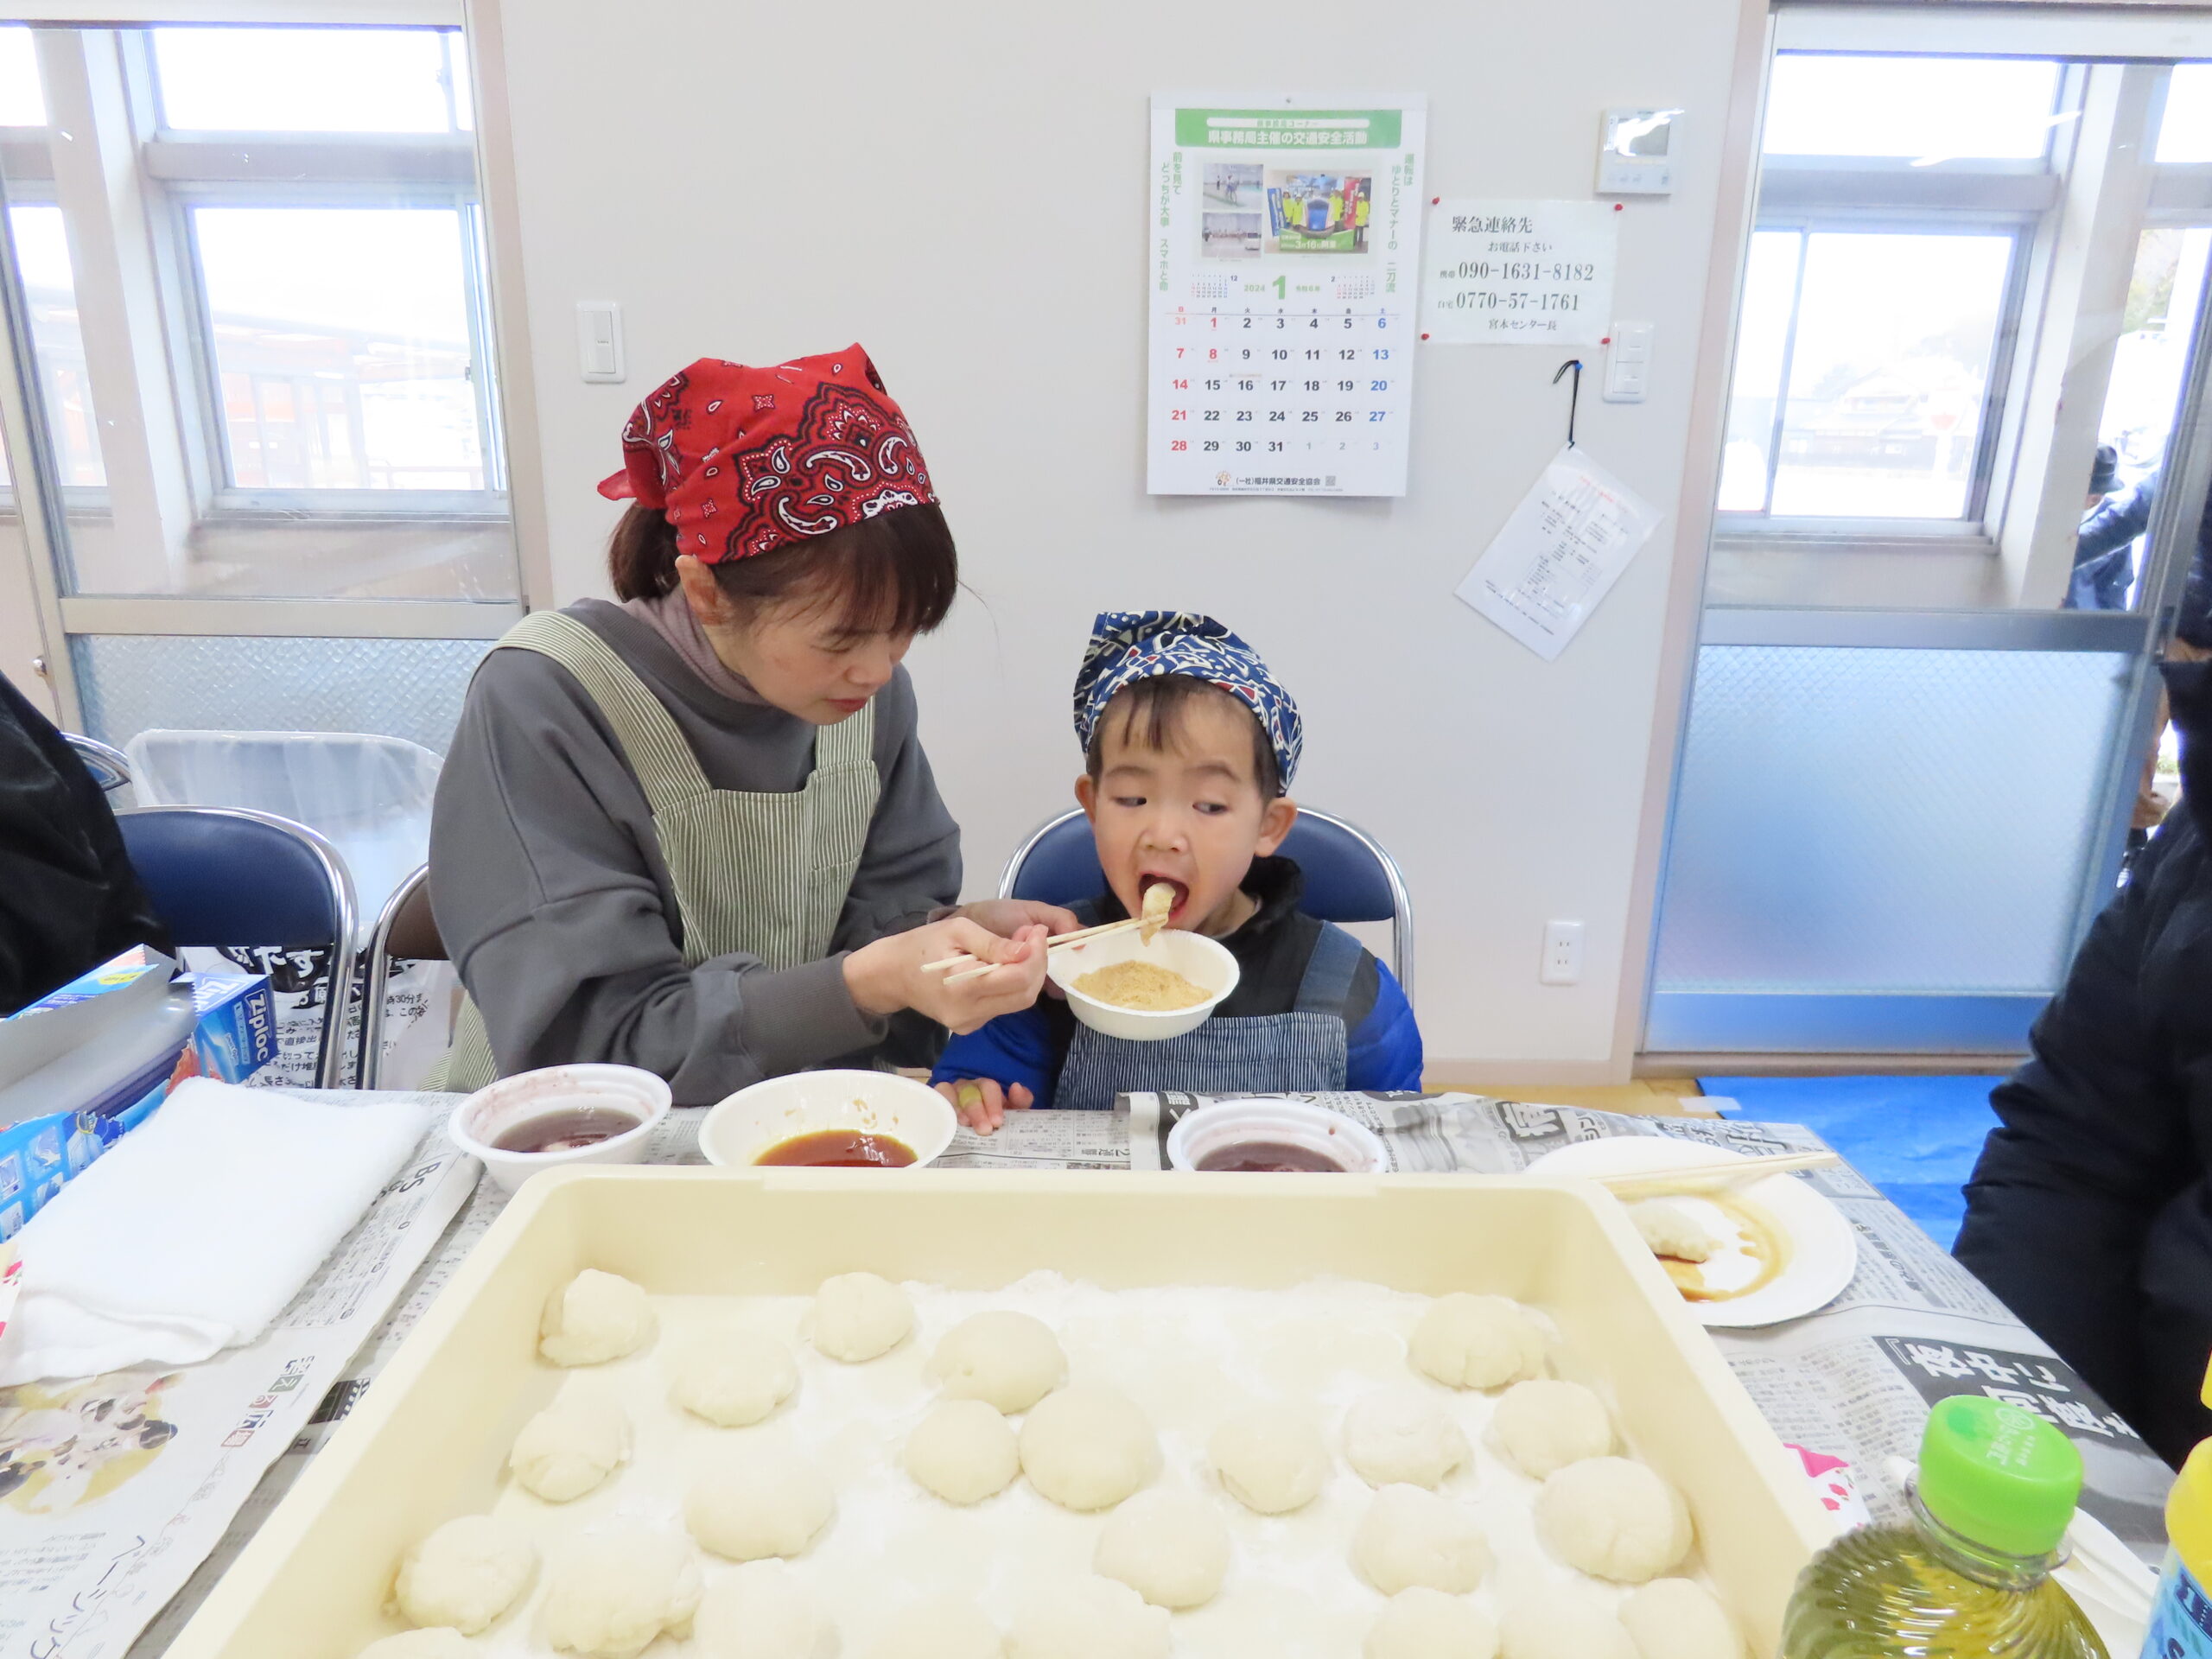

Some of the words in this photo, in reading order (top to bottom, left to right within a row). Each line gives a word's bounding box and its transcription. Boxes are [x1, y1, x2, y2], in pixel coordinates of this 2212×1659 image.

[1208, 130, 1368, 145] 県事務局主催の交通安全活動
[1173, 151, 1183, 195] 前を見て
[1160, 162, 1171, 227] どっちが大事
[1388, 165, 1402, 251] ゆとりとマナーの
[1452, 216, 1533, 233] 緊急連絡先
[1487, 241, 1553, 253] お電話下さい
[1159, 238, 1169, 292] スマホと命
[1459, 262, 1594, 281] 090-1631-8182
[1272, 275, 1286, 300] 1
[1456, 292, 1579, 311] 0770-57-1761
[1174, 316, 1187, 326] 31
[1210, 318, 1217, 328] 1
[1243, 318, 1251, 328] 2
[1276, 319, 1285, 328] 3
[1309, 319, 1319, 328] 4
[1344, 319, 1352, 328] 5
[1377, 318, 1387, 328] 6
[1488, 318, 1557, 331] 宮本センター長
[1176, 348, 1185, 359] 7
[1209, 349, 1217, 359] 8
[1242, 349, 1251, 359] 9
[1271, 350, 1287, 360] 10
[1305, 350, 1320, 360] 11
[1338, 350, 1355, 360] 12
[1372, 349, 1389, 360] 13
[1172, 379, 1188, 390] 14
[1205, 380, 1221, 391] 15
[1237, 380, 1254, 391] 16
[1270, 380, 1287, 391] 17
[1304, 381, 1320, 391] 18
[1337, 381, 1353, 391] 19
[1370, 380, 1388, 391] 20
[1171, 410, 1186, 421] 21
[1204, 410, 1220, 421] 22
[1236, 411, 1253, 422] 23
[1268, 411, 1286, 422] 24
[1301, 411, 1319, 423] 25
[1335, 411, 1352, 423] 26
[1369, 411, 1386, 422] 27
[1171, 441, 1187, 451] 28
[1203, 441, 1219, 452] 29
[1236, 442, 1252, 452] 30
[1268, 442, 1284, 453] 31
[1306, 442, 1312, 451] 1
[1338, 442, 1346, 451] 2
[1372, 442, 1380, 451] 3
[1236, 476, 1321, 486] (一社)福井県交通安全協会
[248, 994, 270, 1062] Ziploc
[1885, 1337, 2071, 1393] 『夜中に
